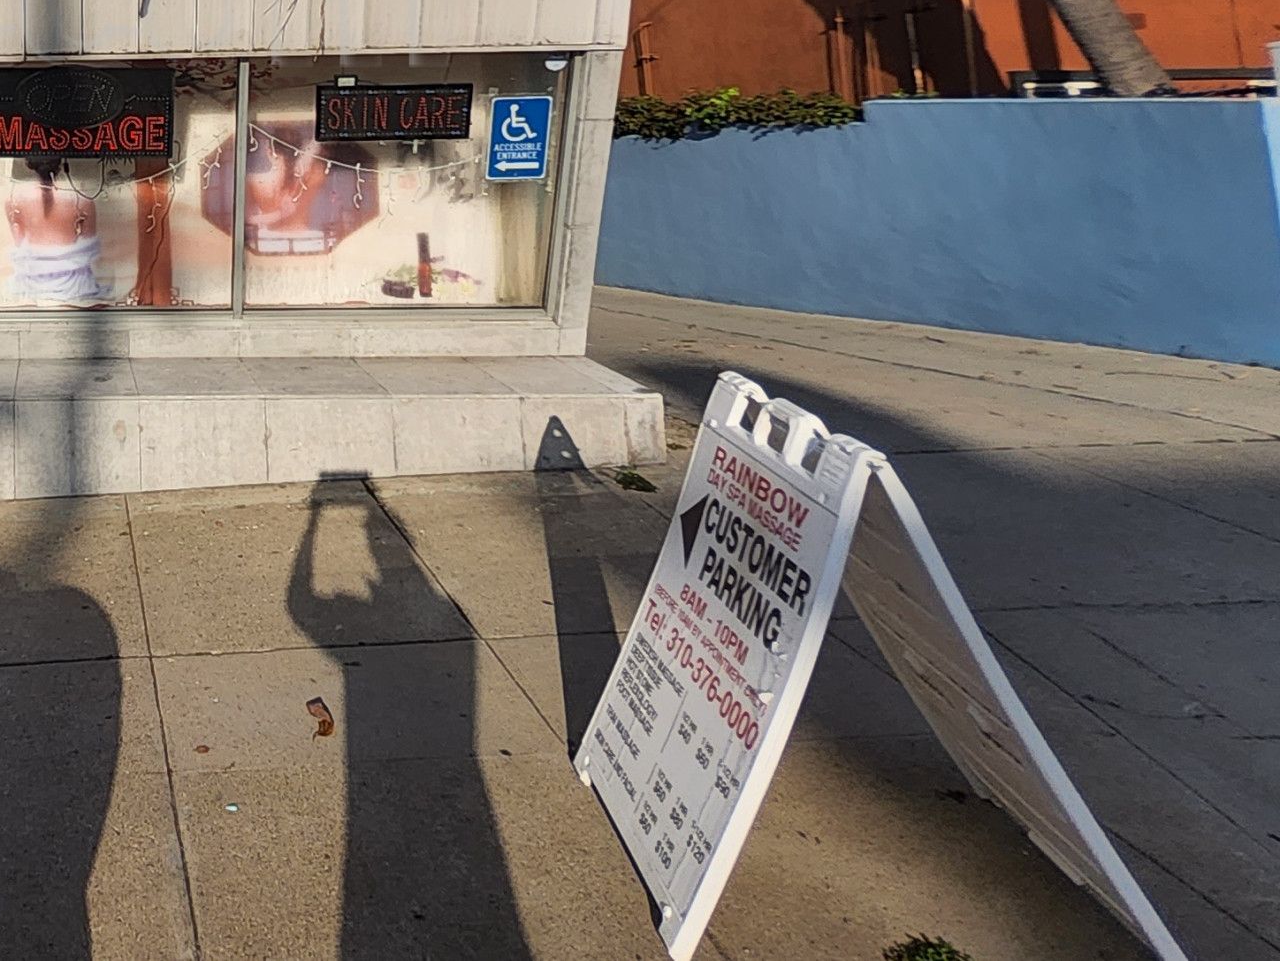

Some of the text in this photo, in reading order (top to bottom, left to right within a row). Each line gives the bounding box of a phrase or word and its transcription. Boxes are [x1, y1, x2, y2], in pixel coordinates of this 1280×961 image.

[26, 84, 114, 114] OPEN
[328, 95, 463, 131] SKIN CARE
[493, 141, 542, 152] ACCESSIBLE
[496, 150, 539, 160] ENTRANCE
[707, 468, 802, 552] DAY SPA MASSAGE
[712, 446, 809, 528] RAINBOW
[699, 546, 782, 649] PARKING
[705, 498, 811, 617] CUSTOMER
[680, 583, 707, 621] 8AM
[714, 620, 750, 666] 10PM
[700, 635, 746, 688] APPOINTMENT
[644, 598, 759, 750] Tel: 310-376-0000
